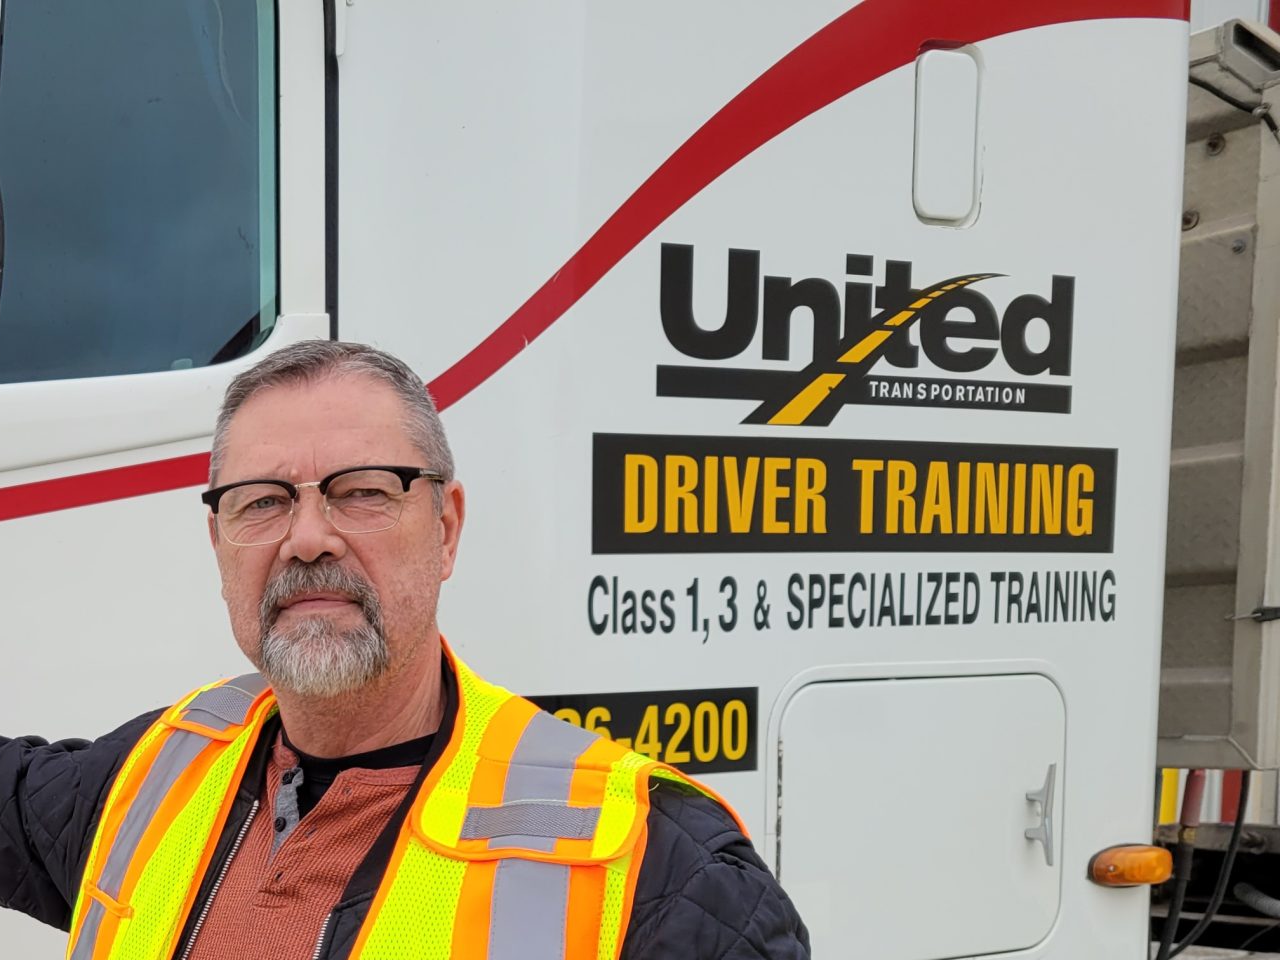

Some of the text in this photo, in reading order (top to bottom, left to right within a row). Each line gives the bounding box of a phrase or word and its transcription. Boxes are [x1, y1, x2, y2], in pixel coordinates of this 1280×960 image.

[659, 243, 1076, 376] United
[868, 380, 1027, 404] TRANSPORTATION
[623, 453, 1095, 536] DRIVER TRAINING
[587, 574, 676, 636] Class
[754, 579, 771, 632] &
[786, 571, 981, 631] SPECIALIZED
[990, 569, 1117, 624] TRAINING
